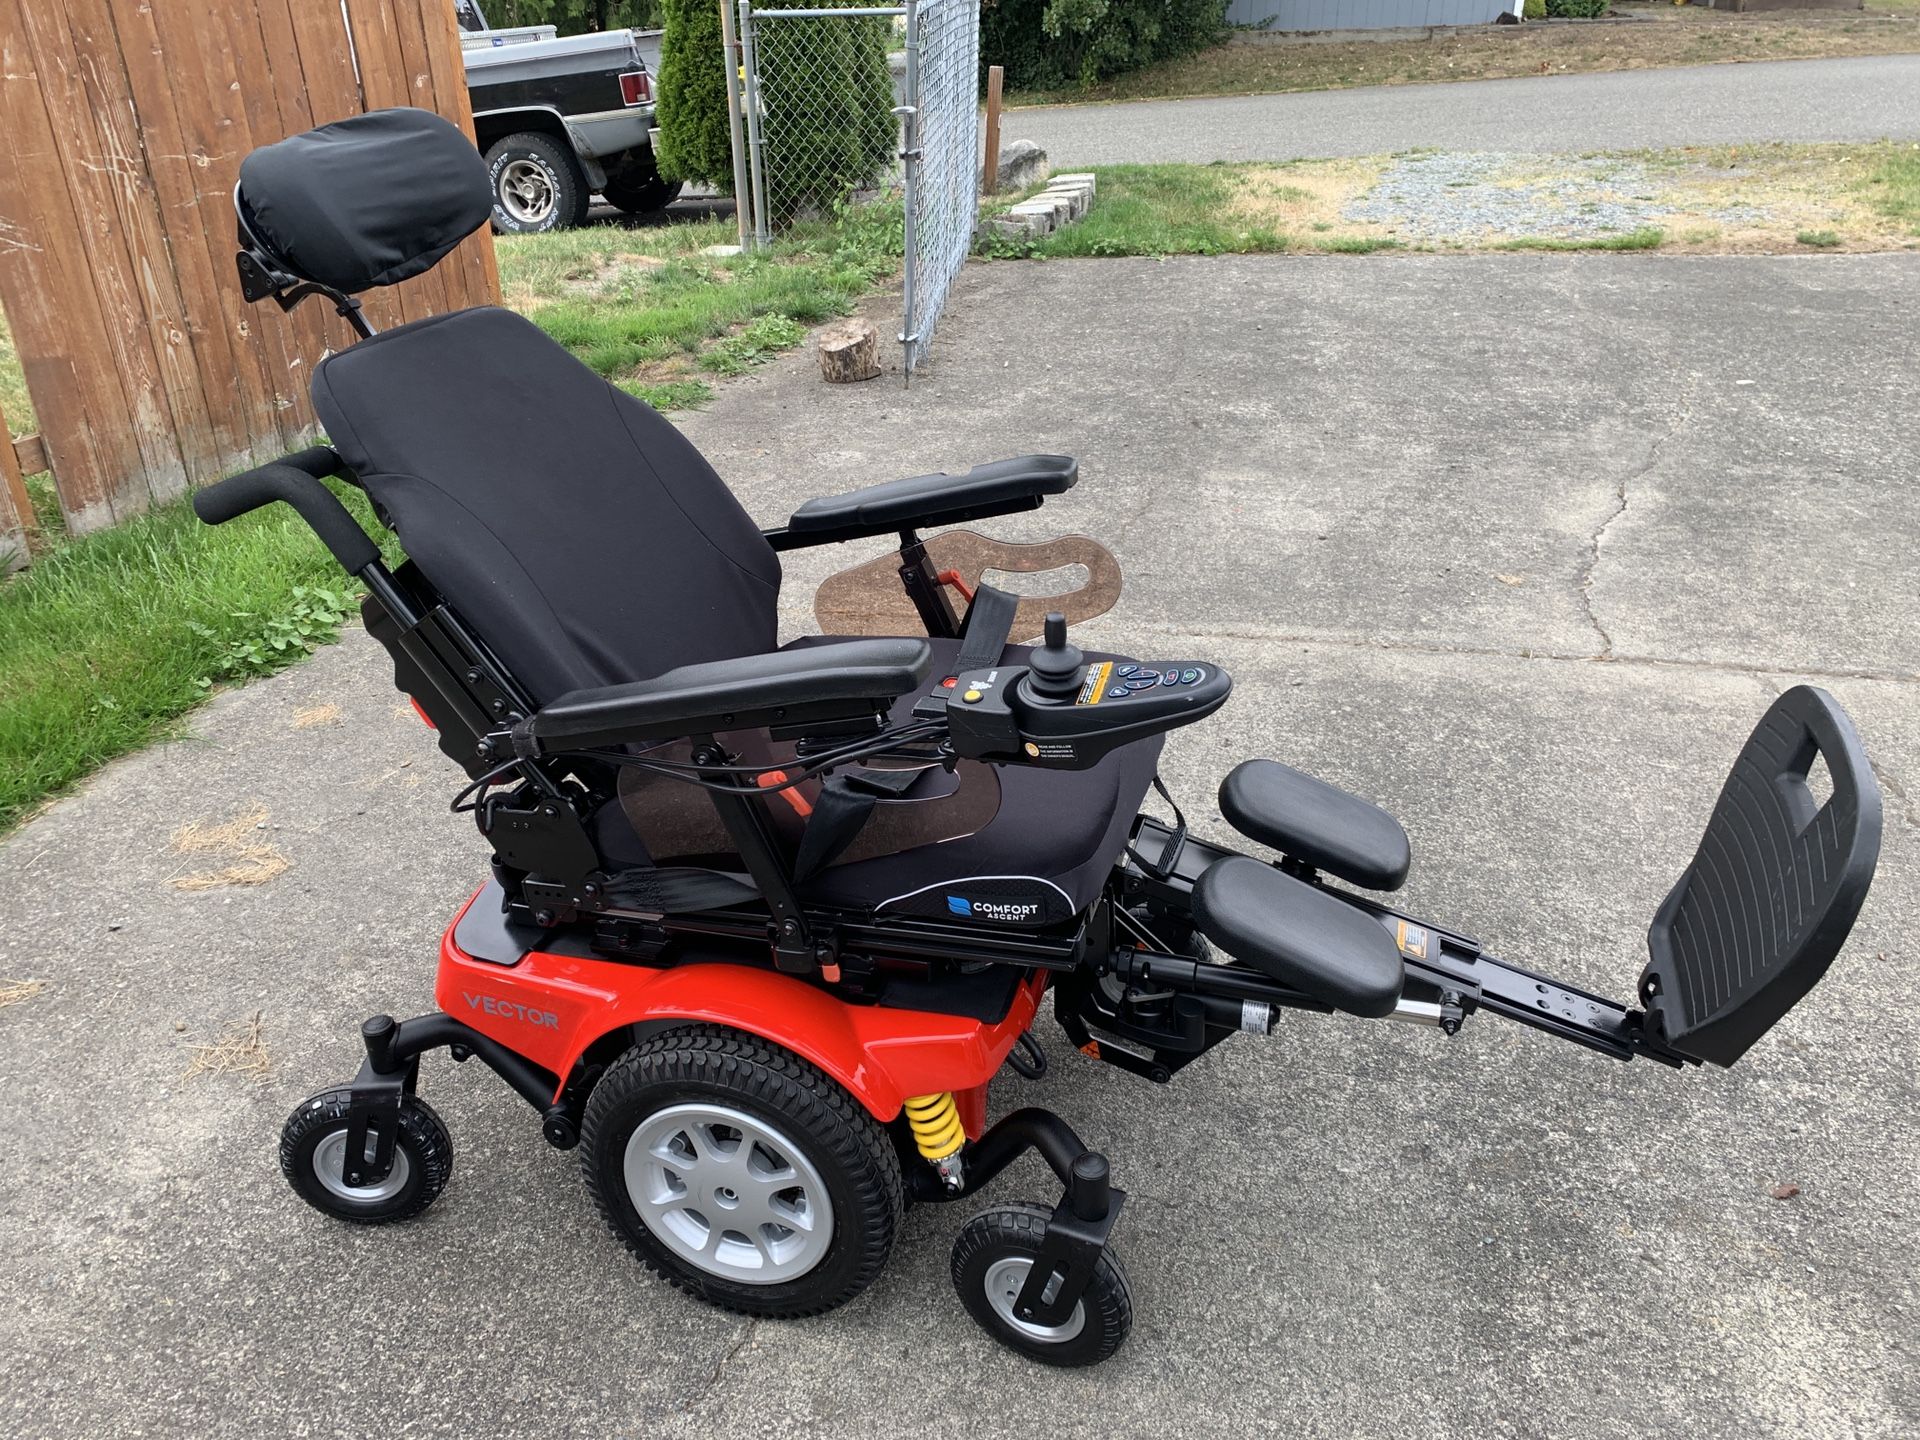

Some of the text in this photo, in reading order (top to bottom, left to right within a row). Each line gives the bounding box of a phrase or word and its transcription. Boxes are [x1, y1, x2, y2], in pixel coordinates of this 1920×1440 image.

[528, 153, 561, 200] RADIAL
[973, 902, 1038, 915] COMFORT
[987, 912, 1026, 921] ASCENT
[463, 991, 559, 1030] VECTOR
